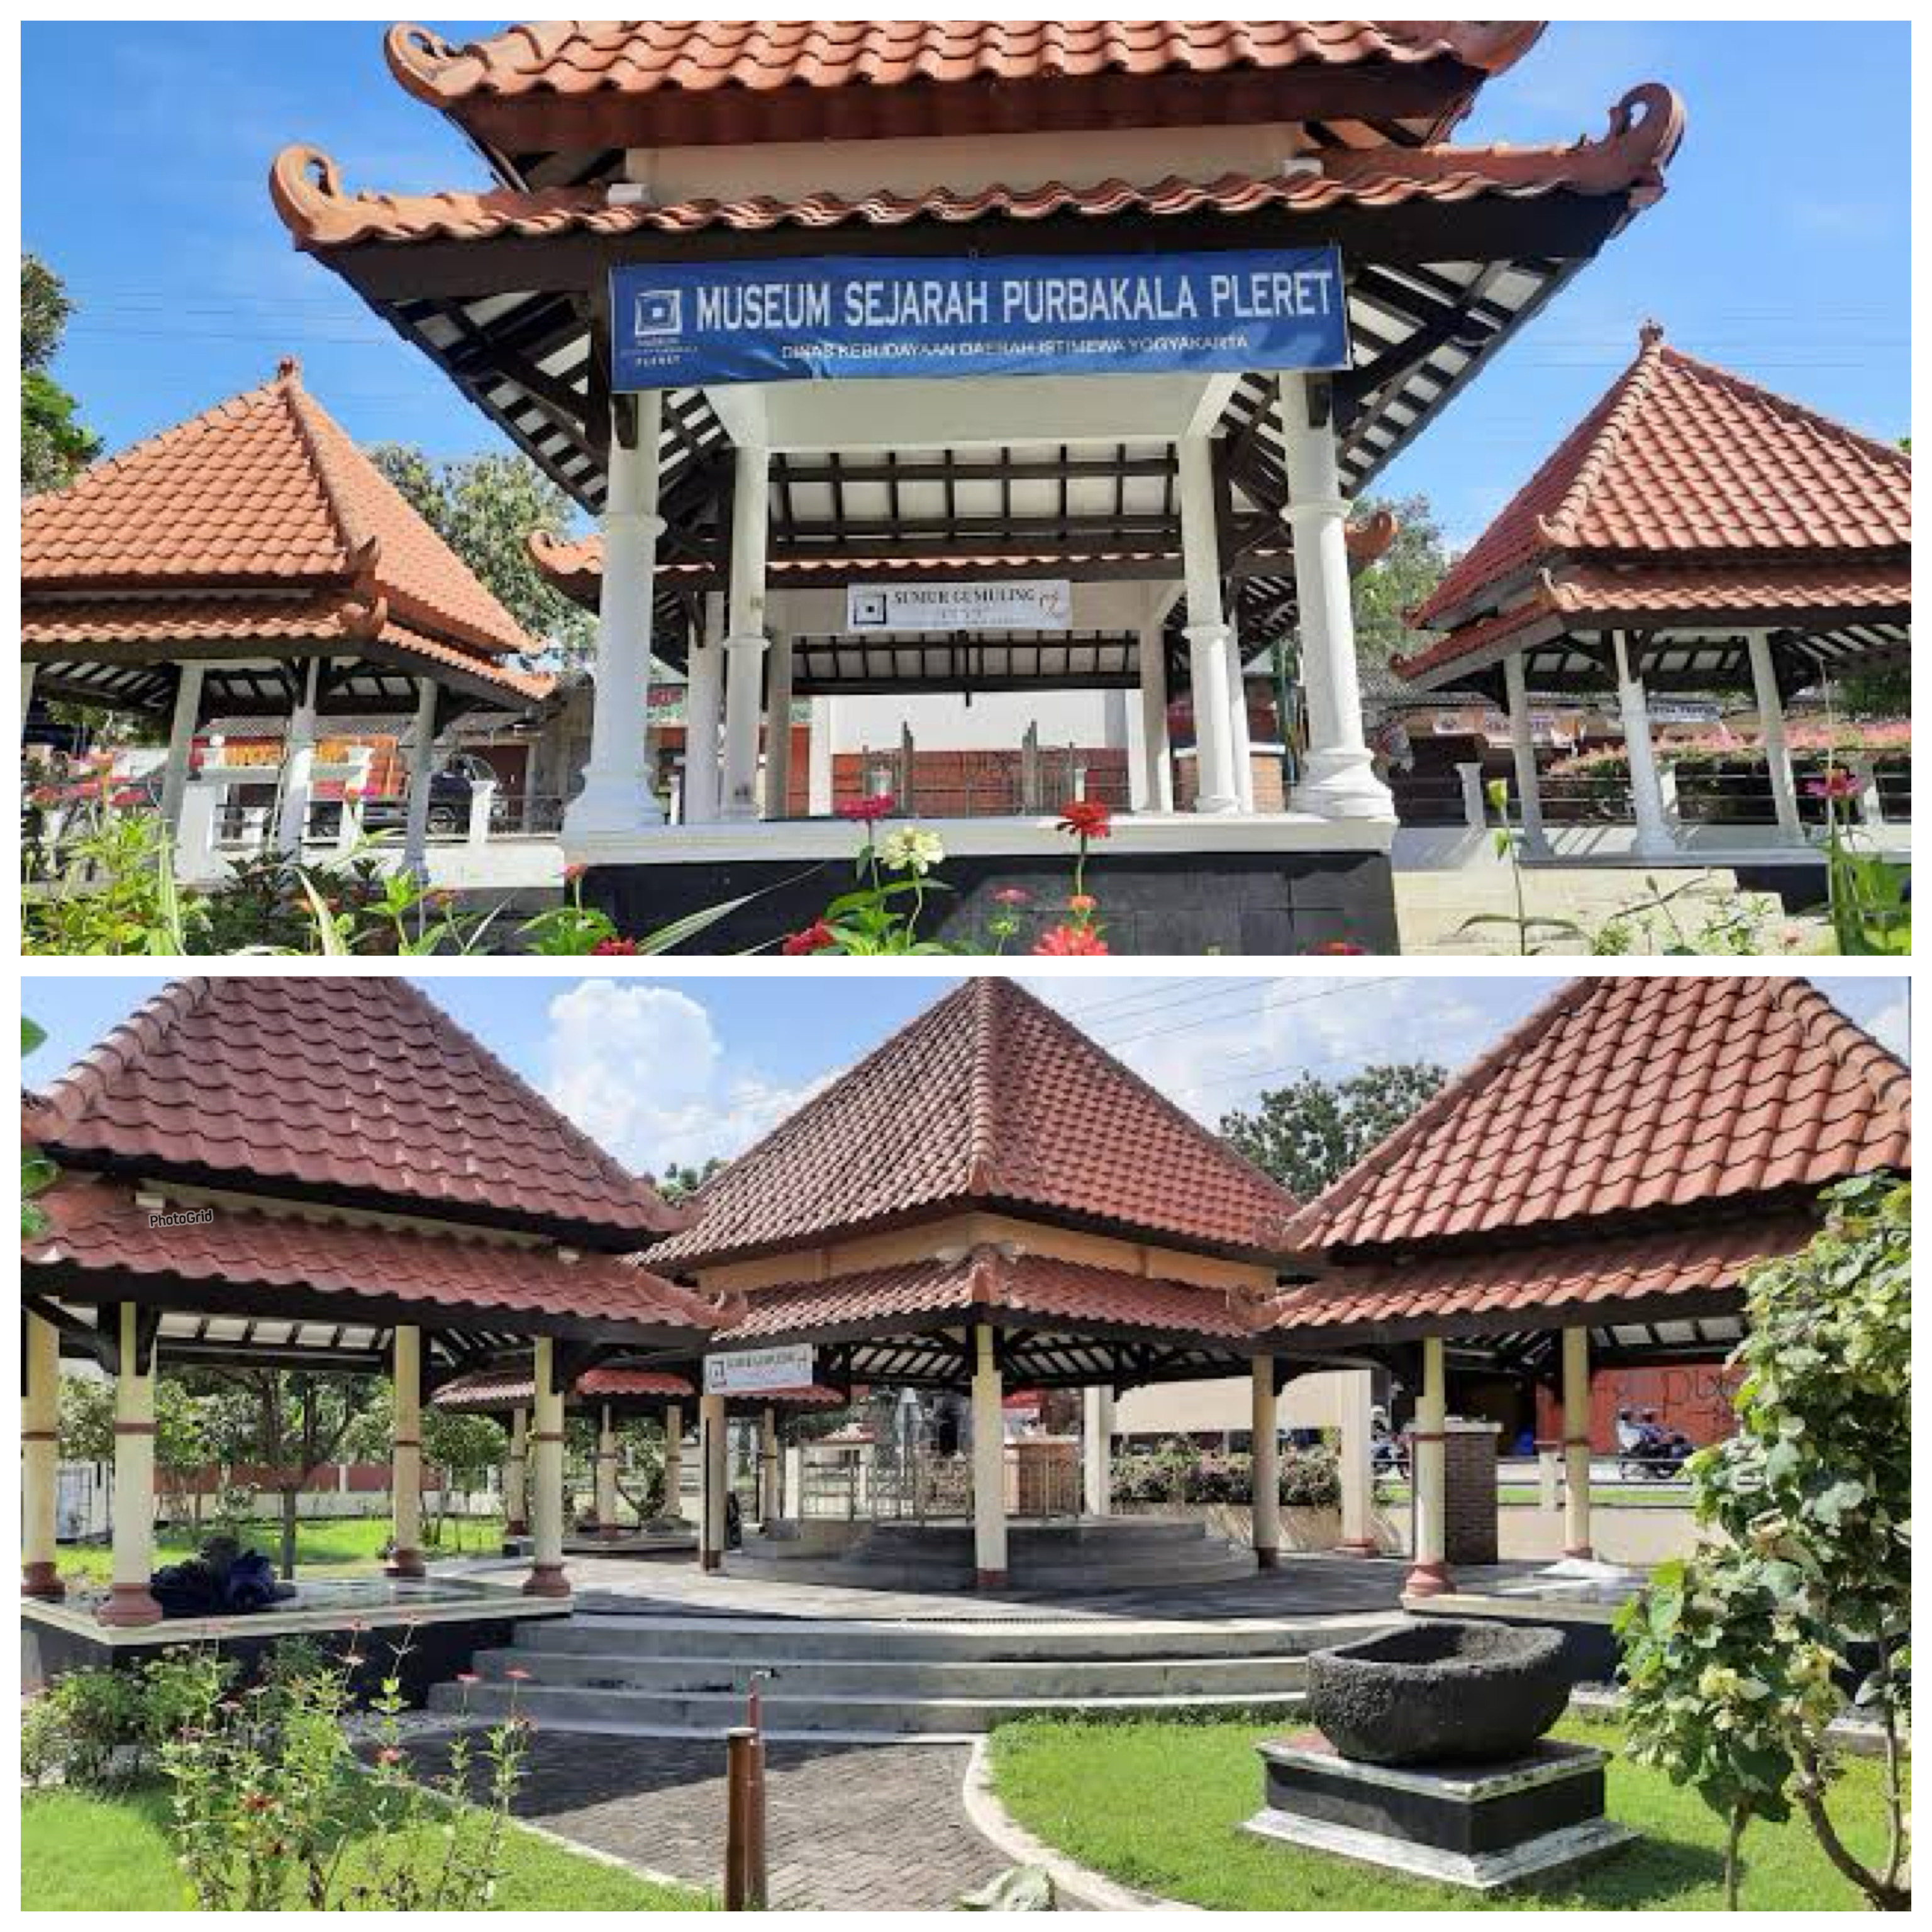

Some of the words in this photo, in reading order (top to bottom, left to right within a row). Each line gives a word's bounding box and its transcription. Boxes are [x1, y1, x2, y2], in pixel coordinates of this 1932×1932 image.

[697, 282, 831, 331] MUSEUM
[844, 280, 987, 326] SEJARAH
[1003, 275, 1197, 323] PURBAKALA
[1210, 269, 1333, 318] PLERET
[782, 343, 833, 359] DINAS
[838, 343, 954, 359] KEBUDAYAAN
